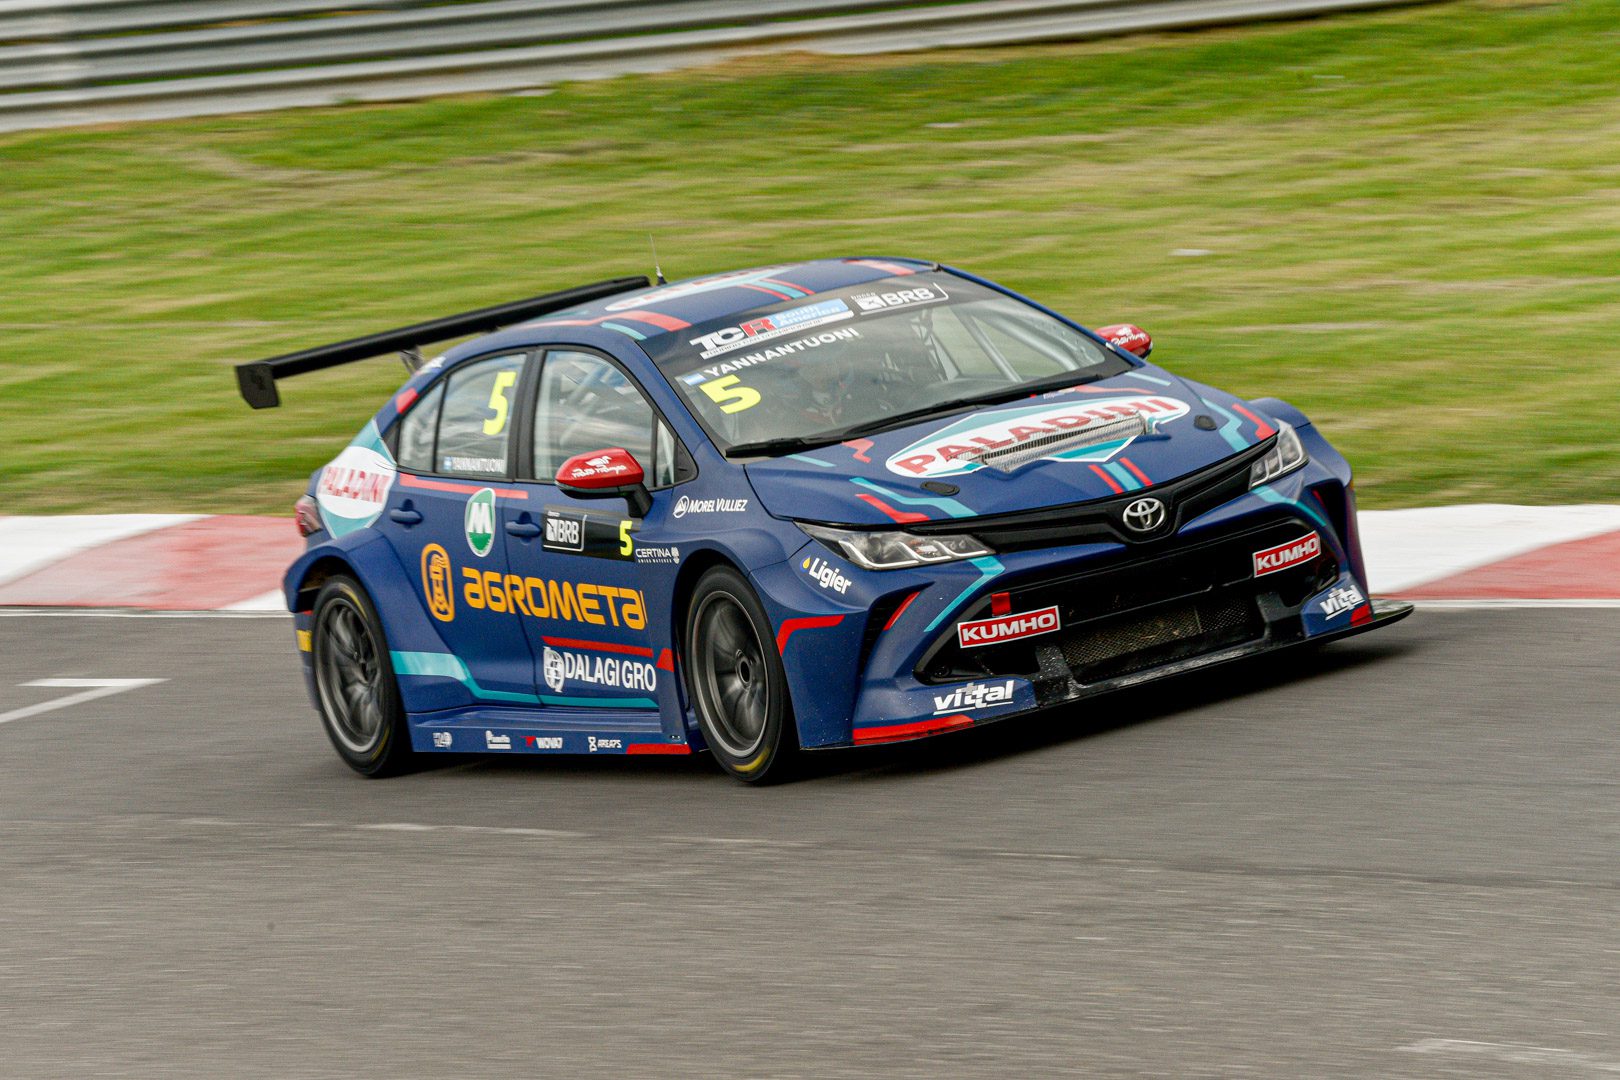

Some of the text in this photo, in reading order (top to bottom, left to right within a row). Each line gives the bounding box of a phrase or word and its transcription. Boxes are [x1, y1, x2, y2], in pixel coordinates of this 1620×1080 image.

[881, 287, 935, 306] BRB
[689, 318, 776, 351] TCR
[704, 327, 860, 377] YANNANTUONI
[482, 371, 517, 435] 5
[698, 374, 762, 415] 5
[894, 398, 1180, 474] PALADINI
[688, 498, 748, 513] MOREL VULLIEZ
[558, 520, 580, 544] BRB
[619, 520, 633, 557] 5
[635, 548, 671, 558] CERTINA
[1257, 537, 1317, 572] KUMHO
[808, 557, 852, 595] Ligier
[962, 612, 1056, 643] KUMHO
[932, 680, 1015, 715] vittal
